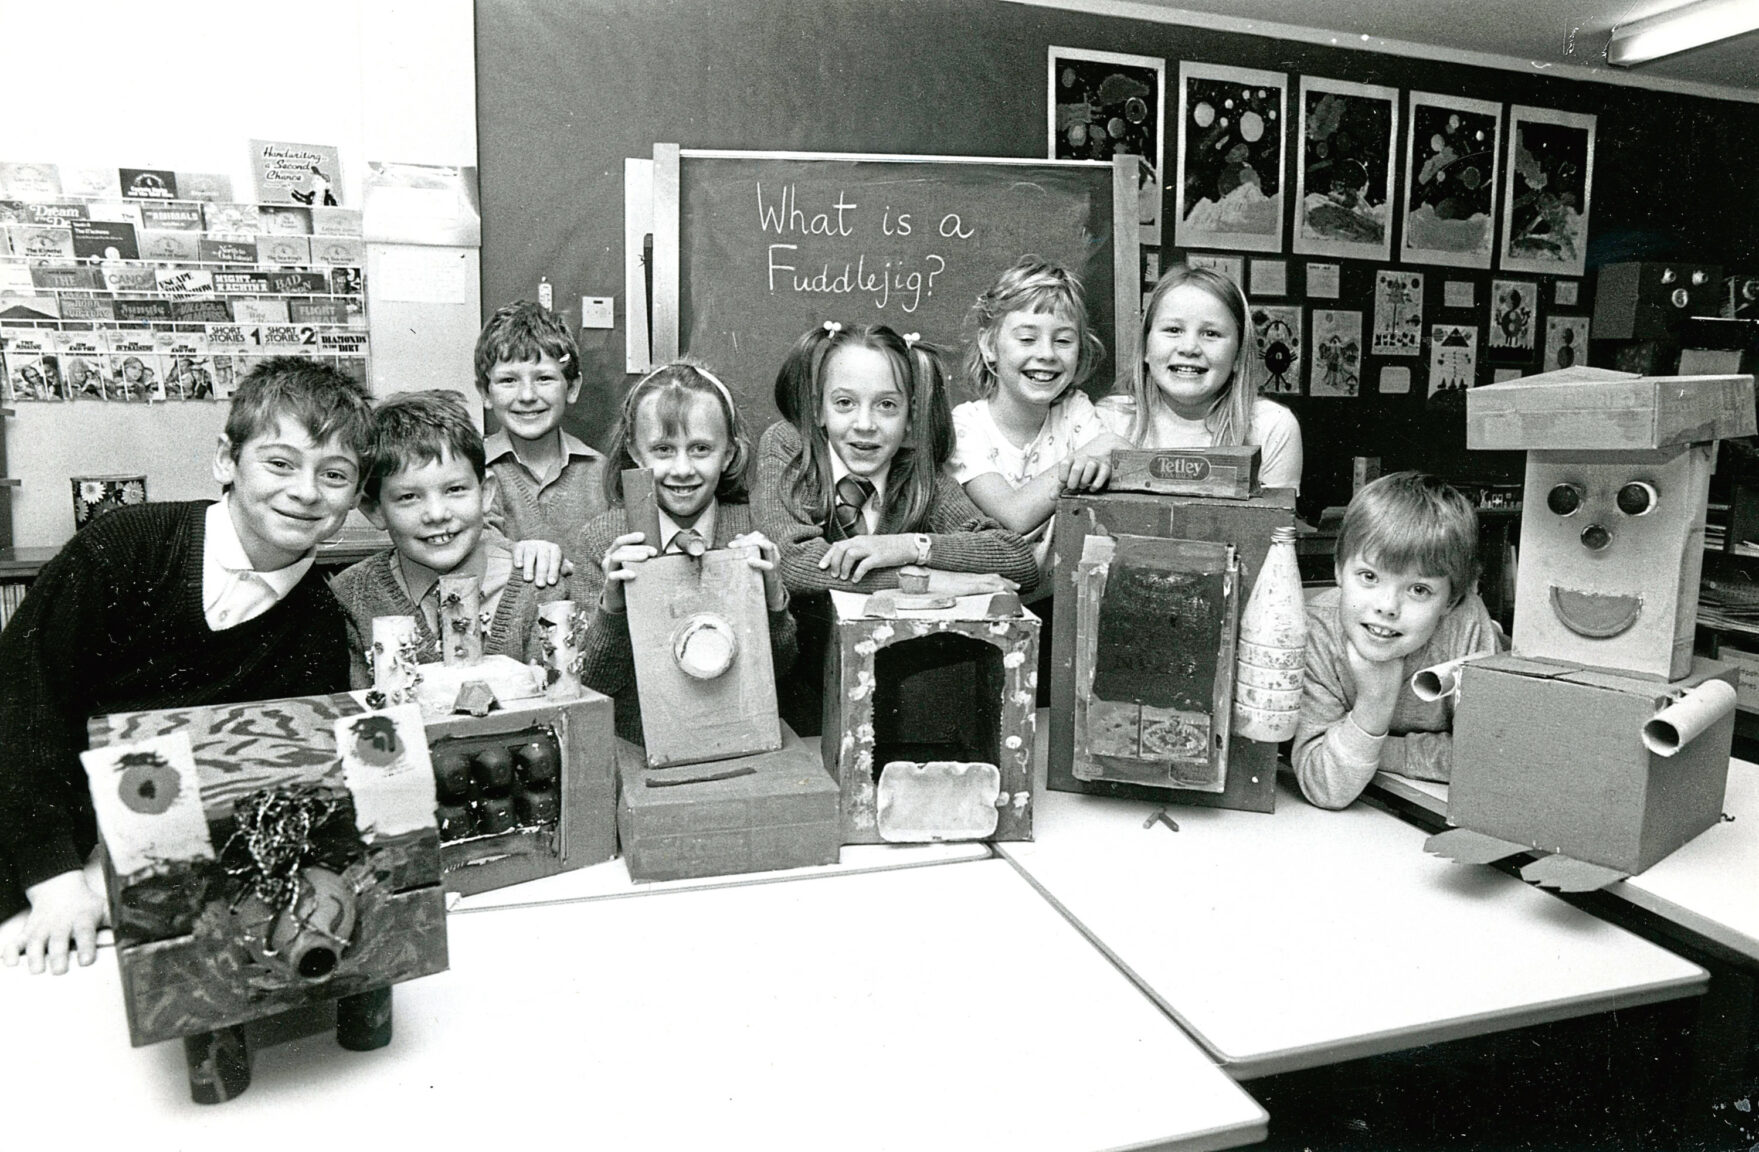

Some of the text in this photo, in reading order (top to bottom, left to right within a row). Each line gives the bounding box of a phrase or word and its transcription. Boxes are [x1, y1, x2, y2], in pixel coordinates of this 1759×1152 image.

[274, 159, 309, 170] Second
[266, 170, 302, 180] Chance
[29, 204, 80, 217] Dream
[757, 182, 974, 238] What is a
[274, 274, 301, 290] BAD
[768, 244, 945, 313] Fuddlejig?
[210, 334, 245, 342] STORIES
[251, 328, 260, 345] 1
[265, 334, 300, 342] STORIES
[301, 327, 316, 345] 2
[322, 336, 366, 344] DIAMONDS
[1158, 457, 1204, 476] Tetley
